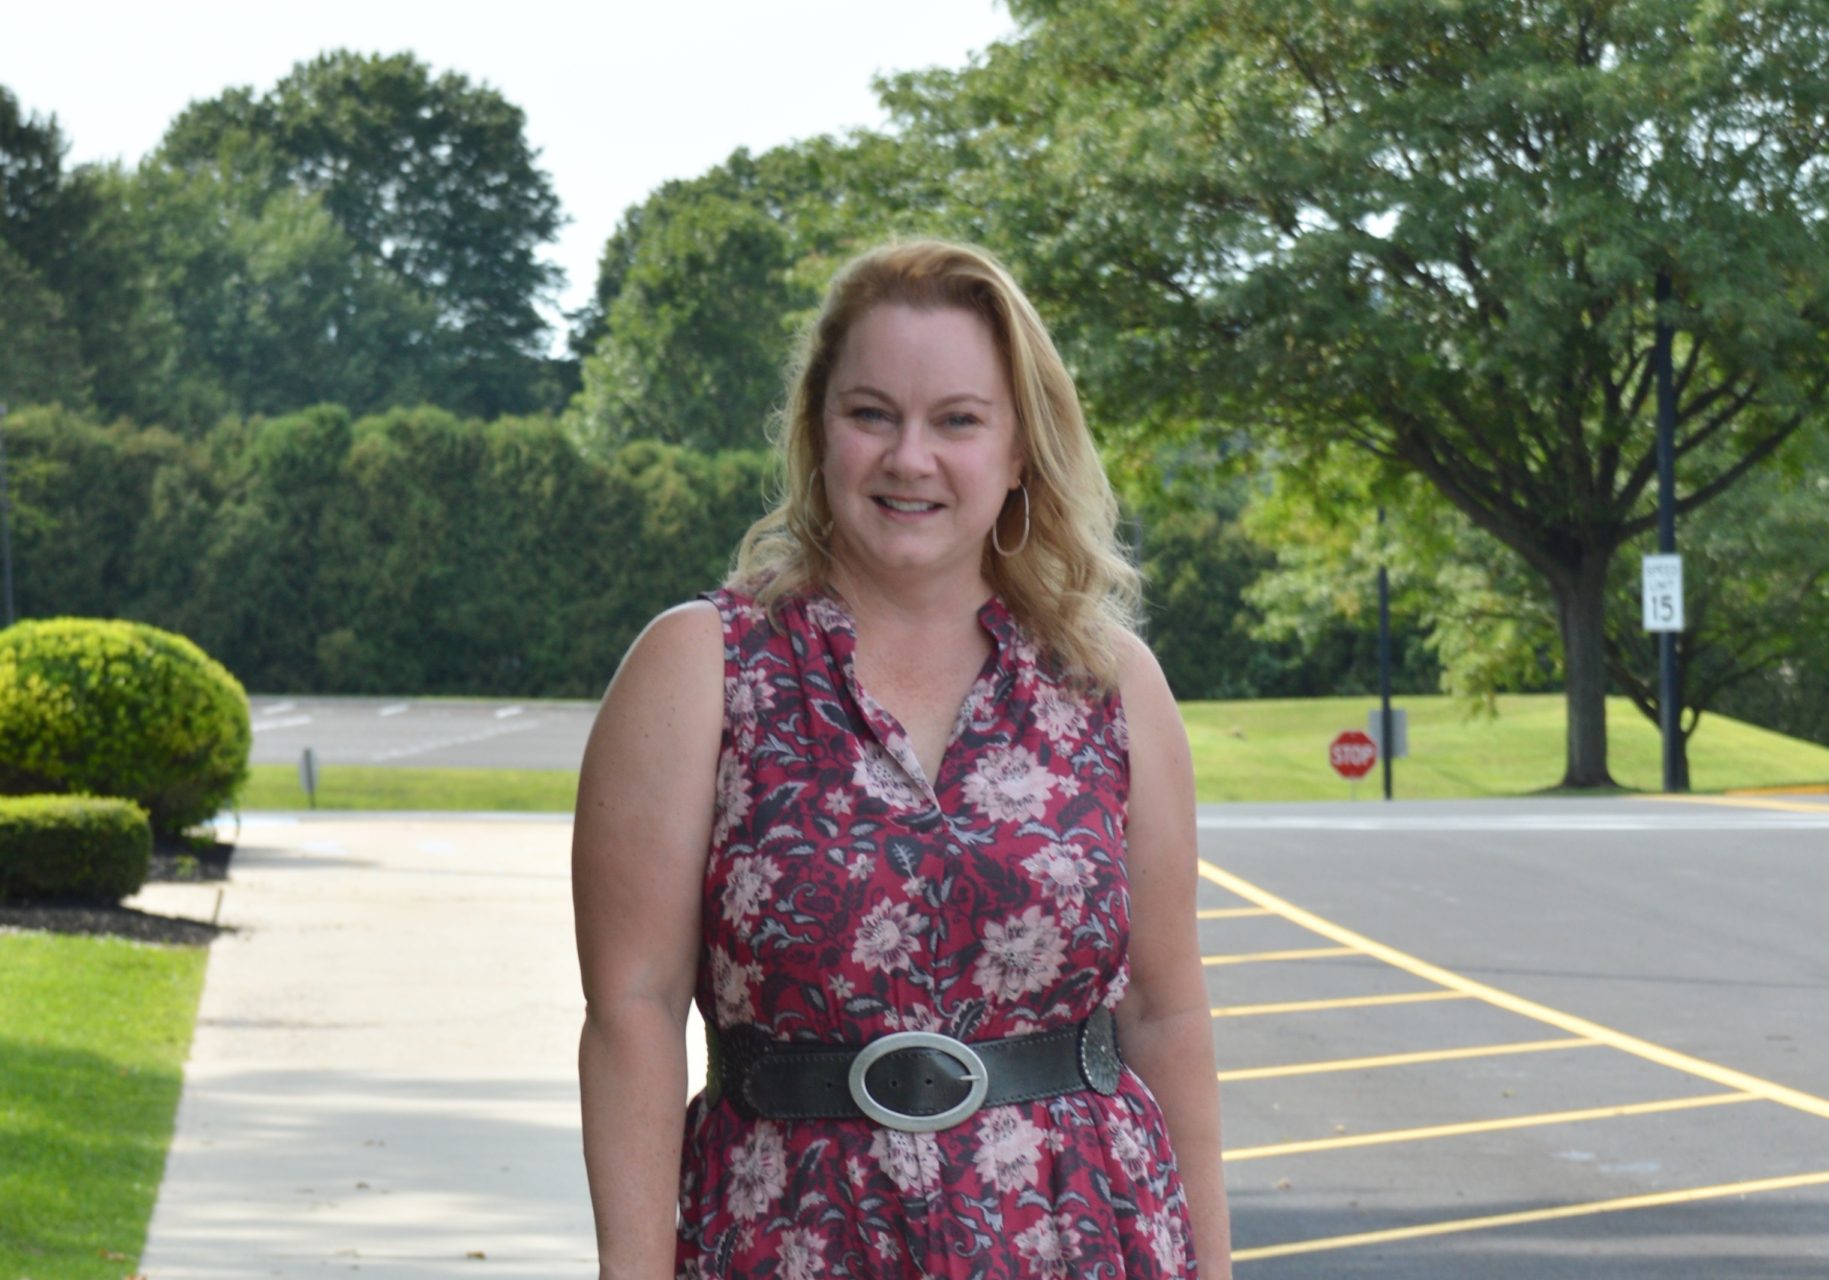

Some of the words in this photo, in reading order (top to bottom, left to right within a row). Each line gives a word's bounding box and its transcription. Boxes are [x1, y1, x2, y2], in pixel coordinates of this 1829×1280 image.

[1647, 566, 1677, 577] SPEED
[1652, 595, 1674, 621] 15
[1332, 743, 1373, 766] STOP
